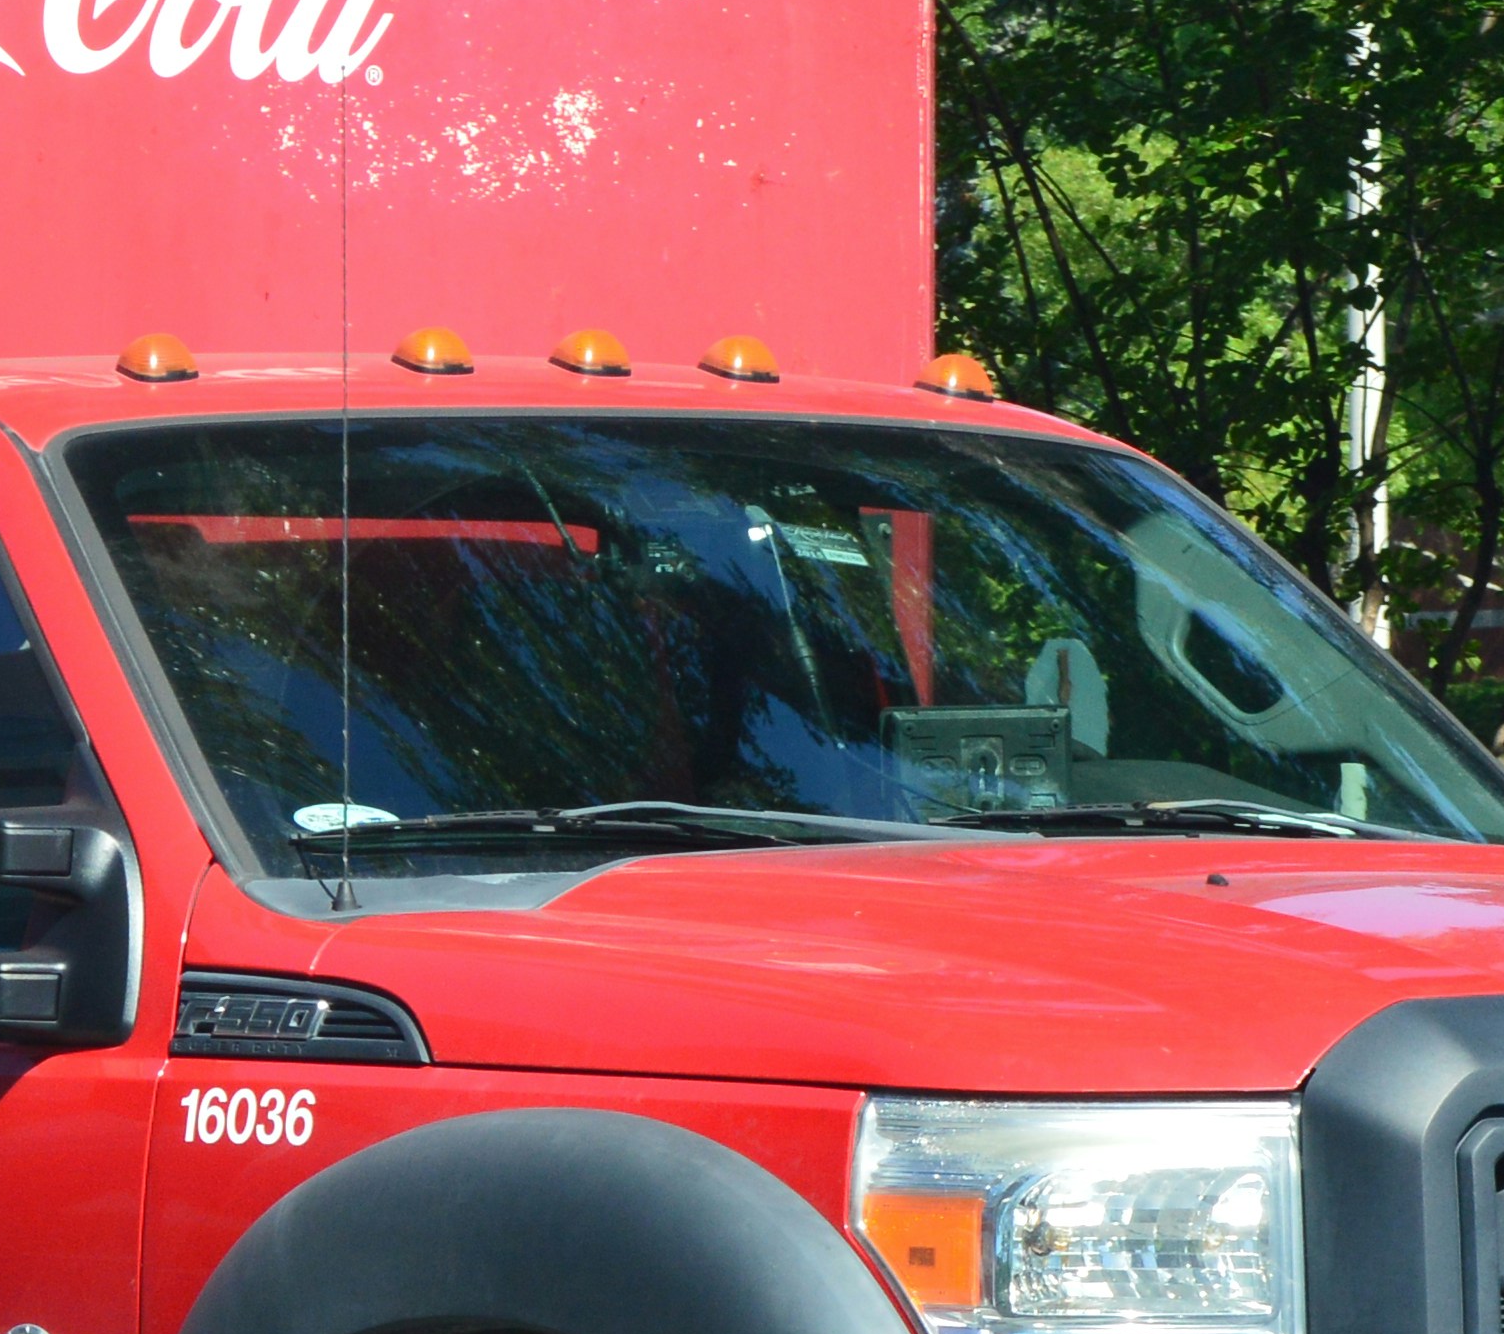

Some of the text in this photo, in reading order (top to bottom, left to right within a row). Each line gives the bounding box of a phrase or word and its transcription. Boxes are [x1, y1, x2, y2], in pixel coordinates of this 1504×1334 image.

[173, 1042, 304, 1055] SUPER DUTY
[180, 1087, 316, 1147] 16036
